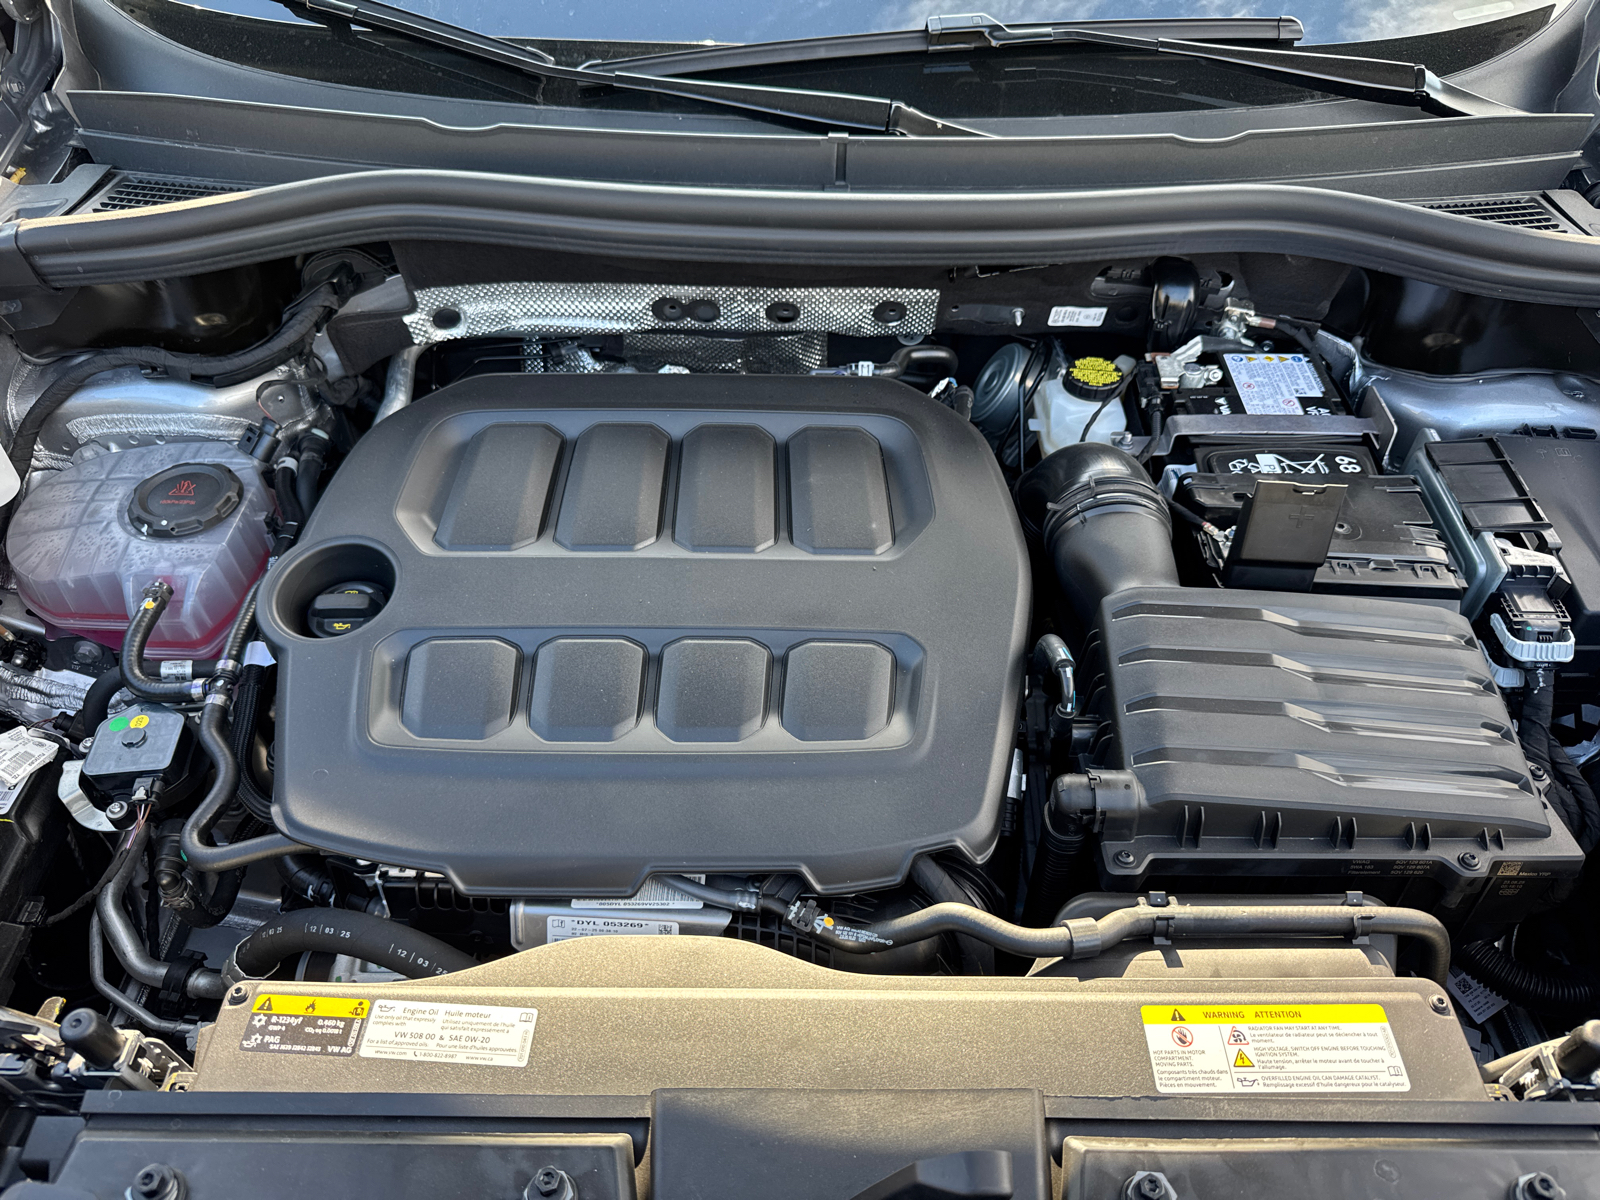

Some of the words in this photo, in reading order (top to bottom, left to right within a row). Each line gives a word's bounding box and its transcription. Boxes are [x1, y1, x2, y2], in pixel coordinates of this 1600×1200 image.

[1334, 456, 1362, 473] 68
[310, 925, 317, 933] 12
[340, 930, 351, 938] 25
[397, 948, 406, 958] 12
[417, 958, 429, 968] 03
[403, 1007, 427, 1016] Engine
[1202, 1011, 1245, 1019] WARNING
[270, 1016, 303, 1026] R-1234yf
[336, 1020, 345, 1028] kg
[264, 1035, 280, 1043] PAG
[409, 1032, 423, 1040] 508
[464, 1036, 490, 1044] 0W-20
[327, 1045, 340, 1053] VW
[340, 1046, 352, 1054] AG
